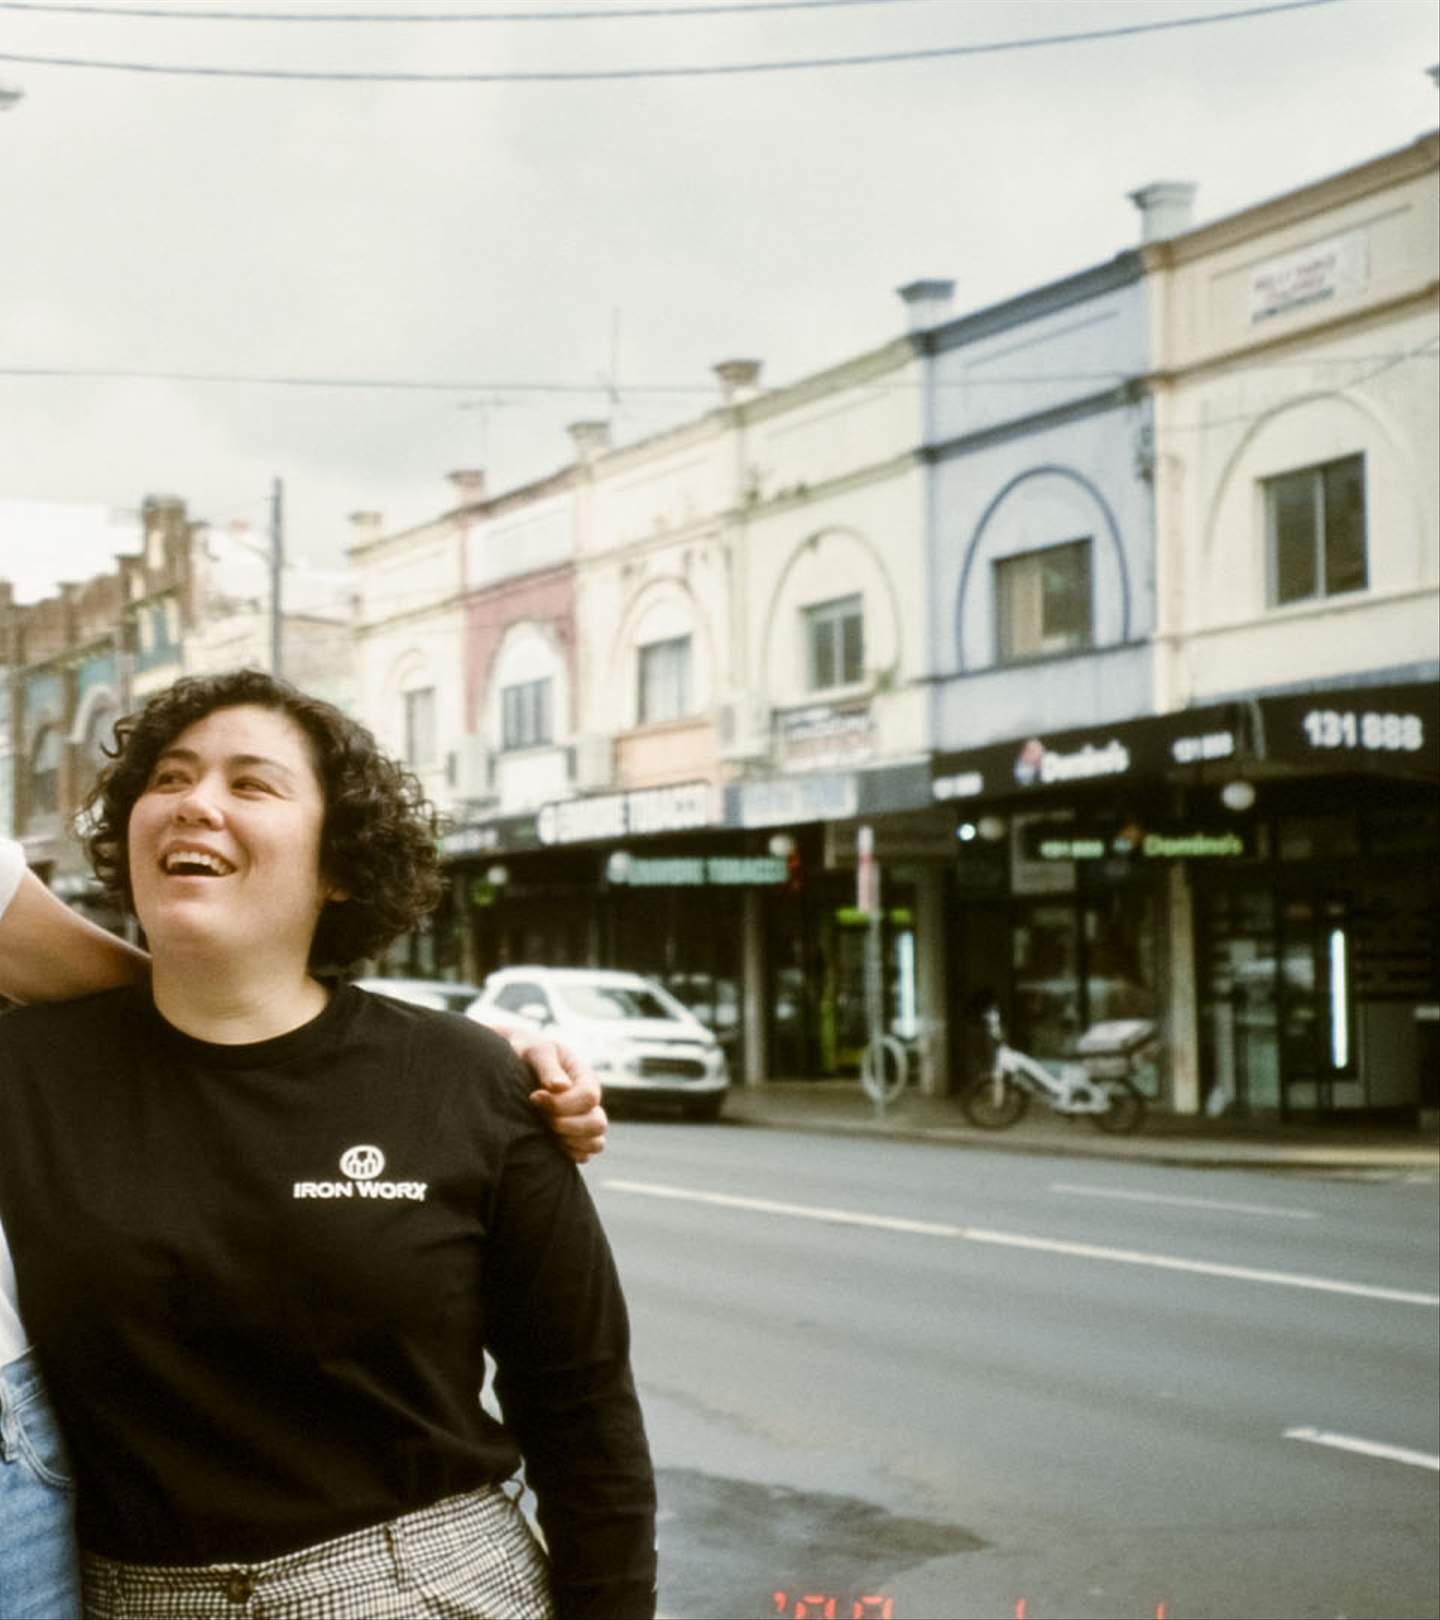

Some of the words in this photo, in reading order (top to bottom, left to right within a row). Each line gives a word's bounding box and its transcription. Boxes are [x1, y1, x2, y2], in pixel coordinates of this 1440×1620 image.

[1303, 708, 1357, 749] 131
[1360, 711, 1425, 752] 888
[293, 1181, 354, 1199] IRON
[355, 1181, 429, 1201] WORX
